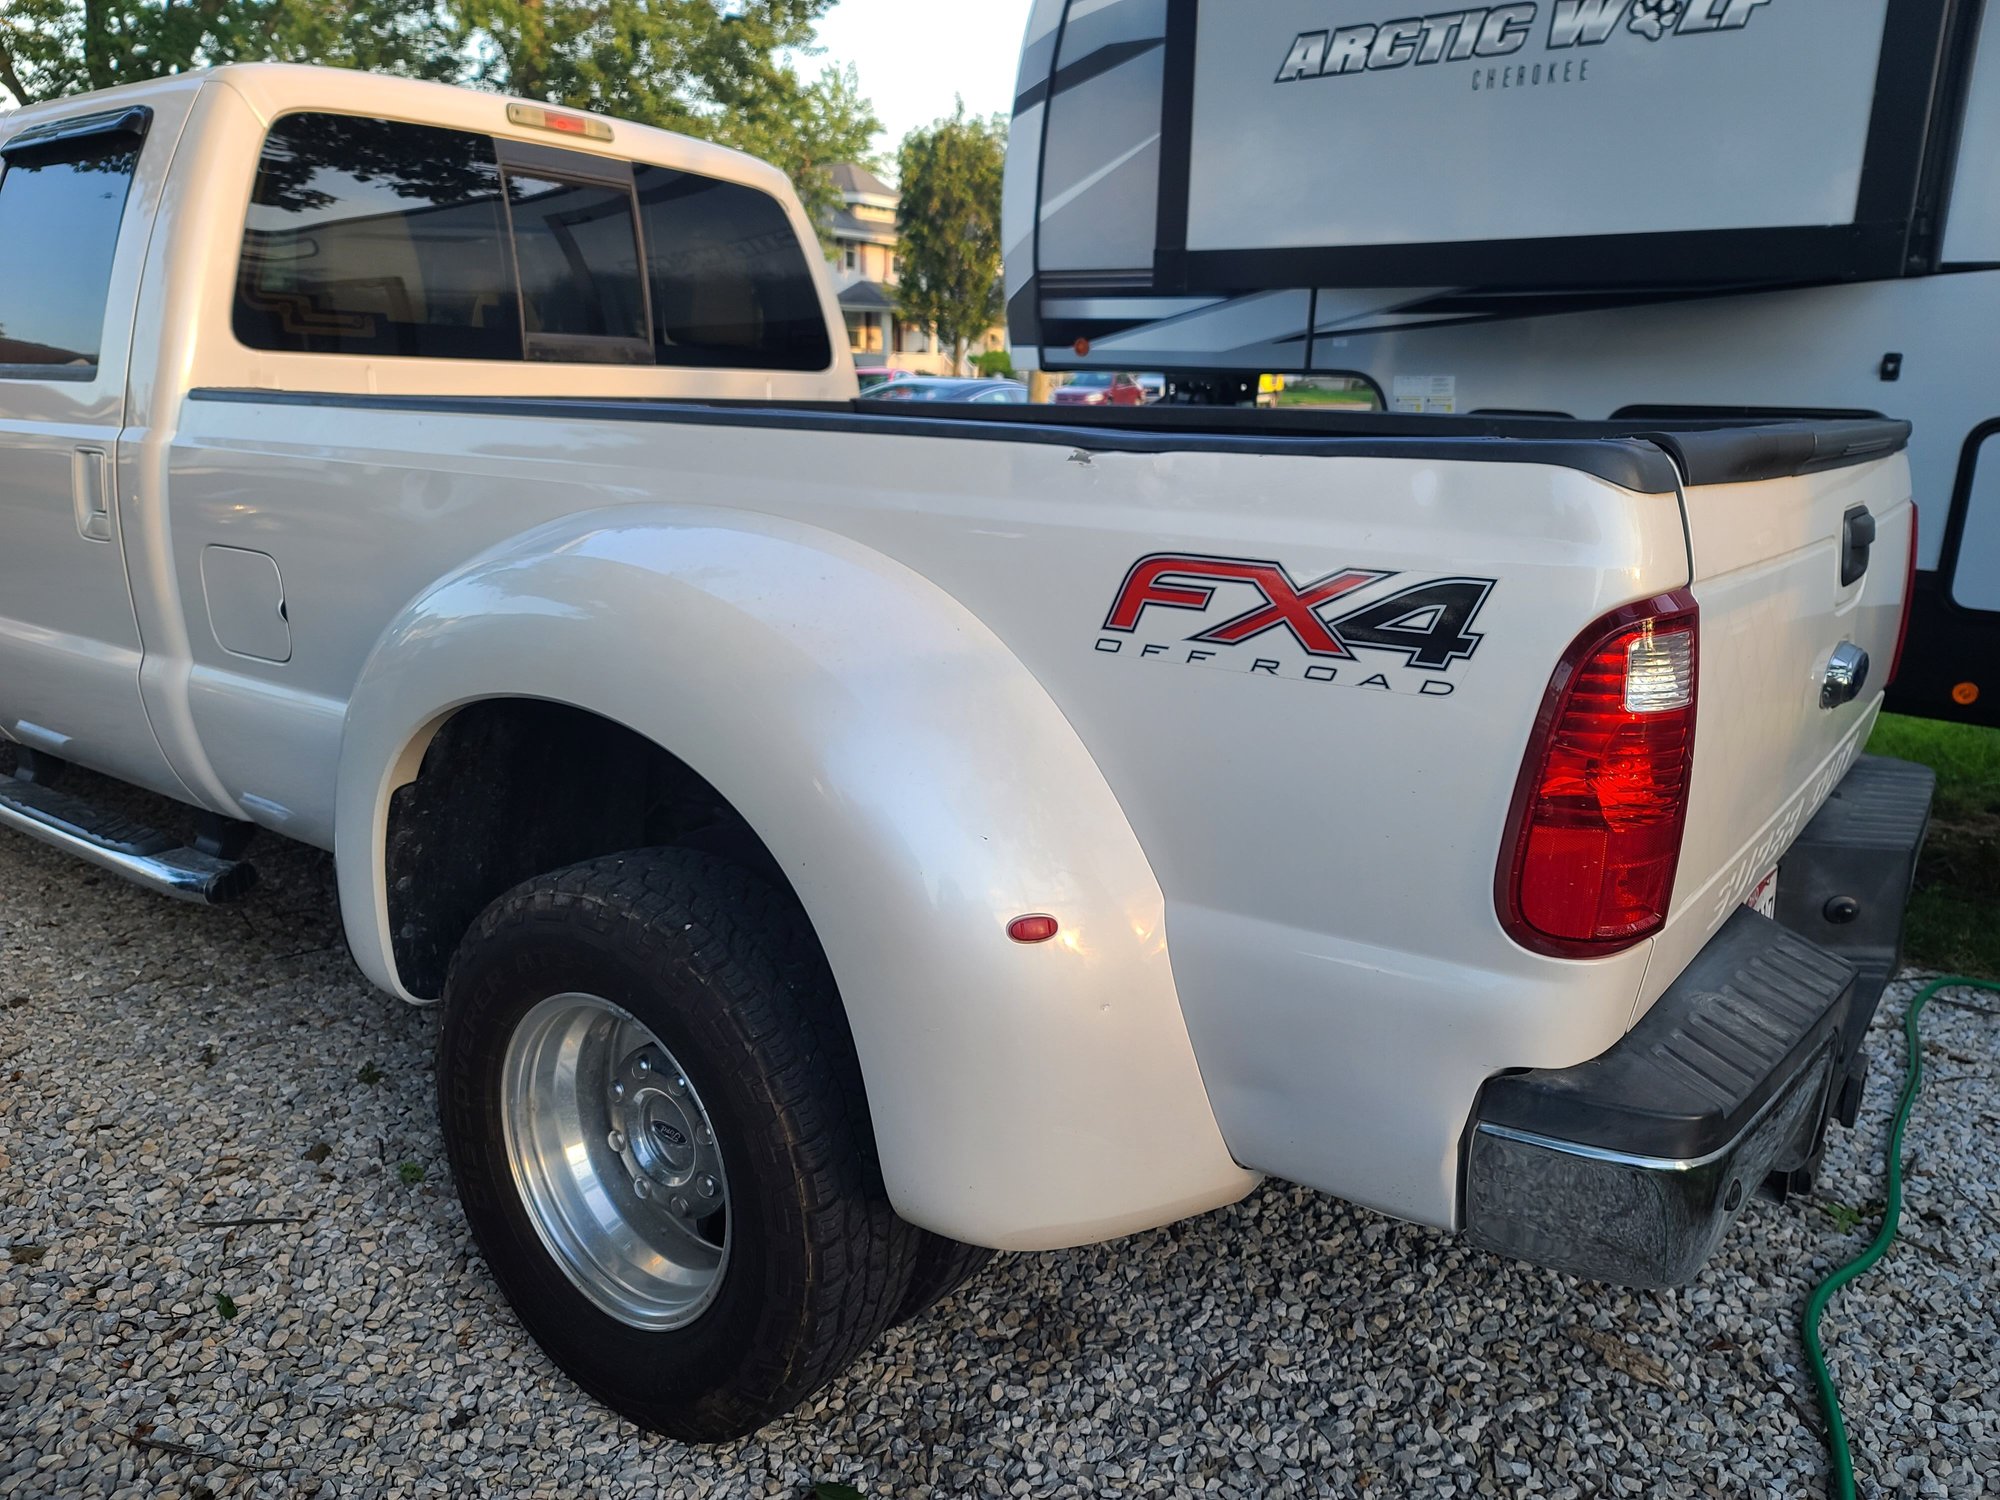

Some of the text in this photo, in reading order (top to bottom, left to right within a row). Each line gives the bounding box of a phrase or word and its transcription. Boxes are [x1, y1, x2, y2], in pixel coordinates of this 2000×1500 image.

[1274, 2, 1538, 83] ARCTIC
[1472, 59, 1590, 91] CHEROKEE
[1102, 552, 1498, 672] FX4
[1094, 638, 1455, 696] OFF ROAD
[1707, 798, 1805, 930] SUPER
[660, 1125, 682, 1142] Ford
